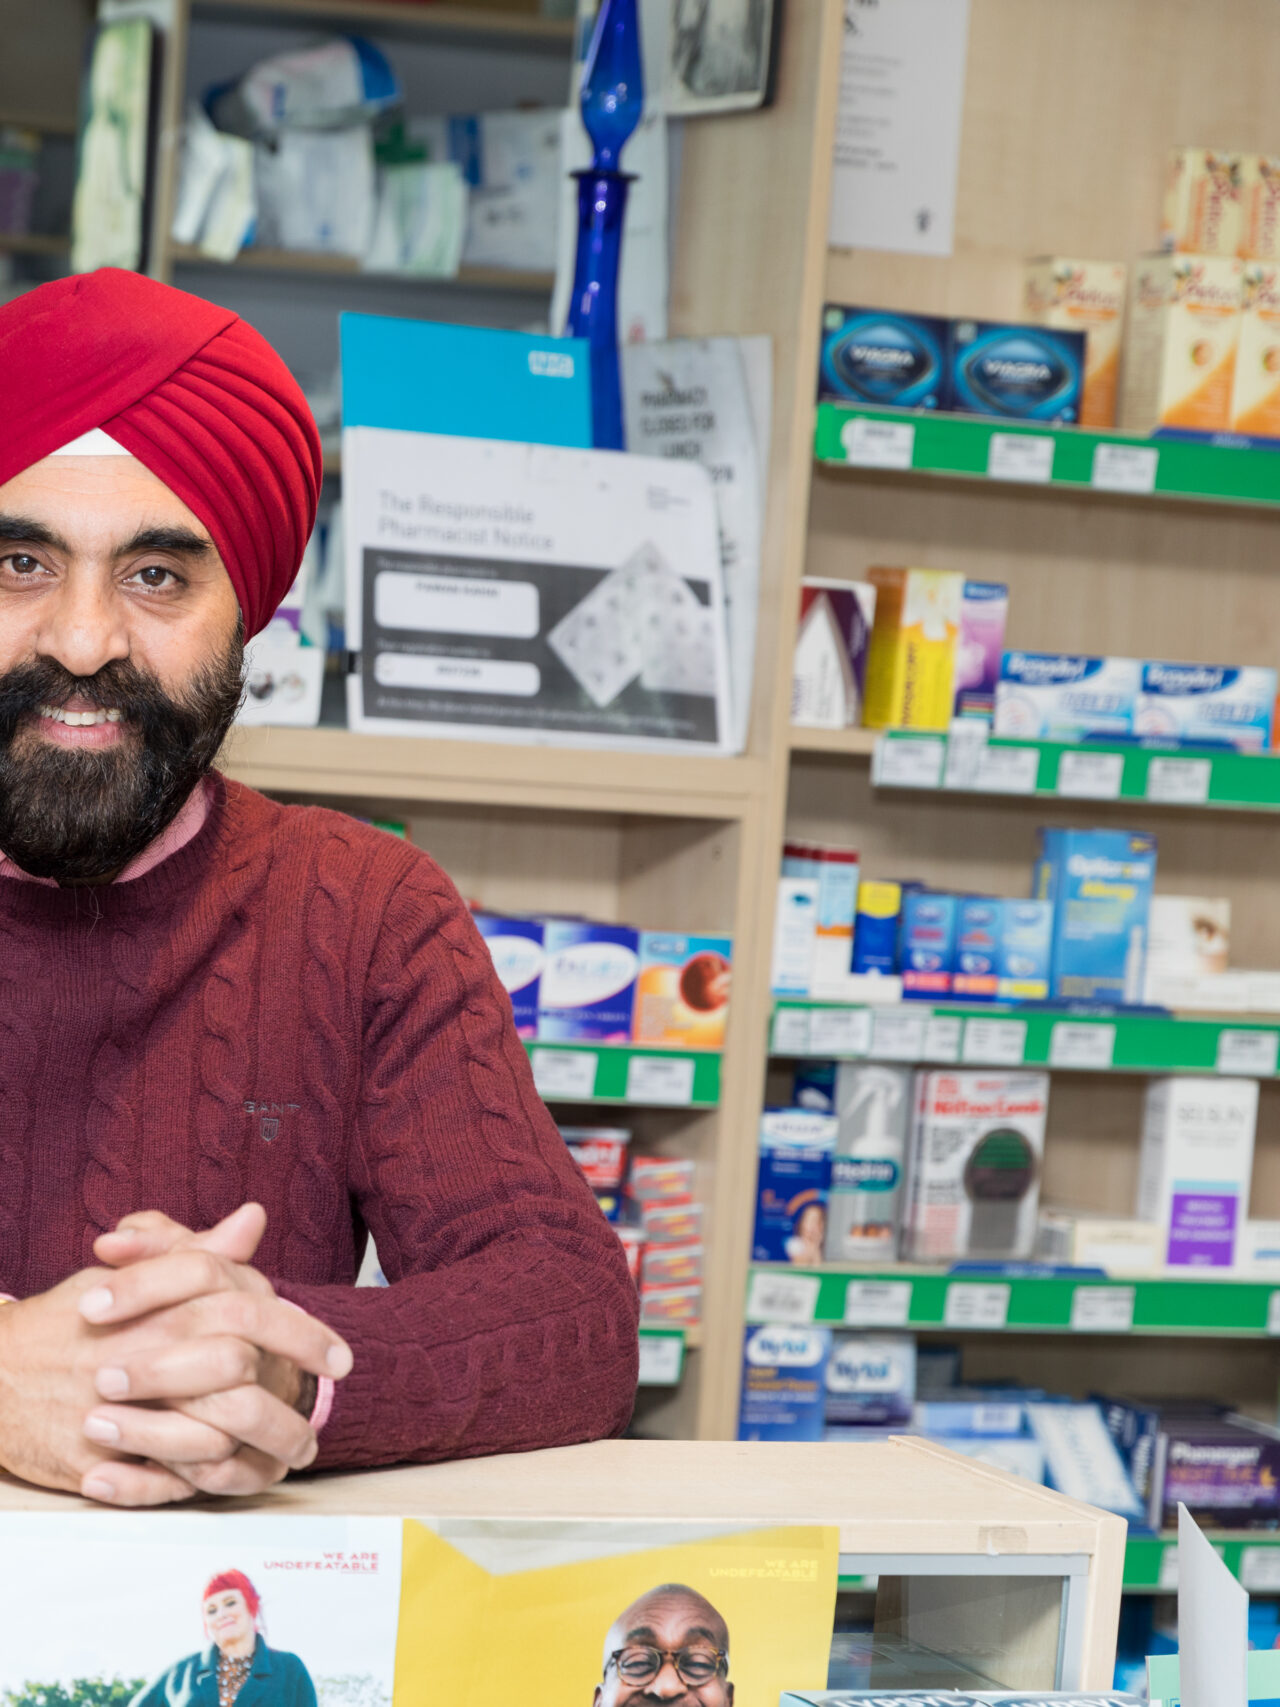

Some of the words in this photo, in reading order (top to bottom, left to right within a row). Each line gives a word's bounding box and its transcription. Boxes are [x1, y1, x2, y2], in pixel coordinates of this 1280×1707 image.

[850, 344, 915, 366] VIAGRA
[984, 358, 1051, 380] VIAGRA
[377, 490, 412, 512] The
[420, 494, 534, 524] Responsible
[377, 515, 486, 546] Pharmacist
[493, 526, 555, 550] Notice
[1171, 1440, 1260, 1469] Phenergan
[263, 1561, 379, 1572] UNDEFEATABLE
[323, 1552, 345, 1561] WE
[350, 1552, 379, 1561] ARE
[765, 1560, 786, 1570] WE
[789, 1560, 818, 1570] ARE
[709, 1567, 818, 1579] UNDEFEATABLE
